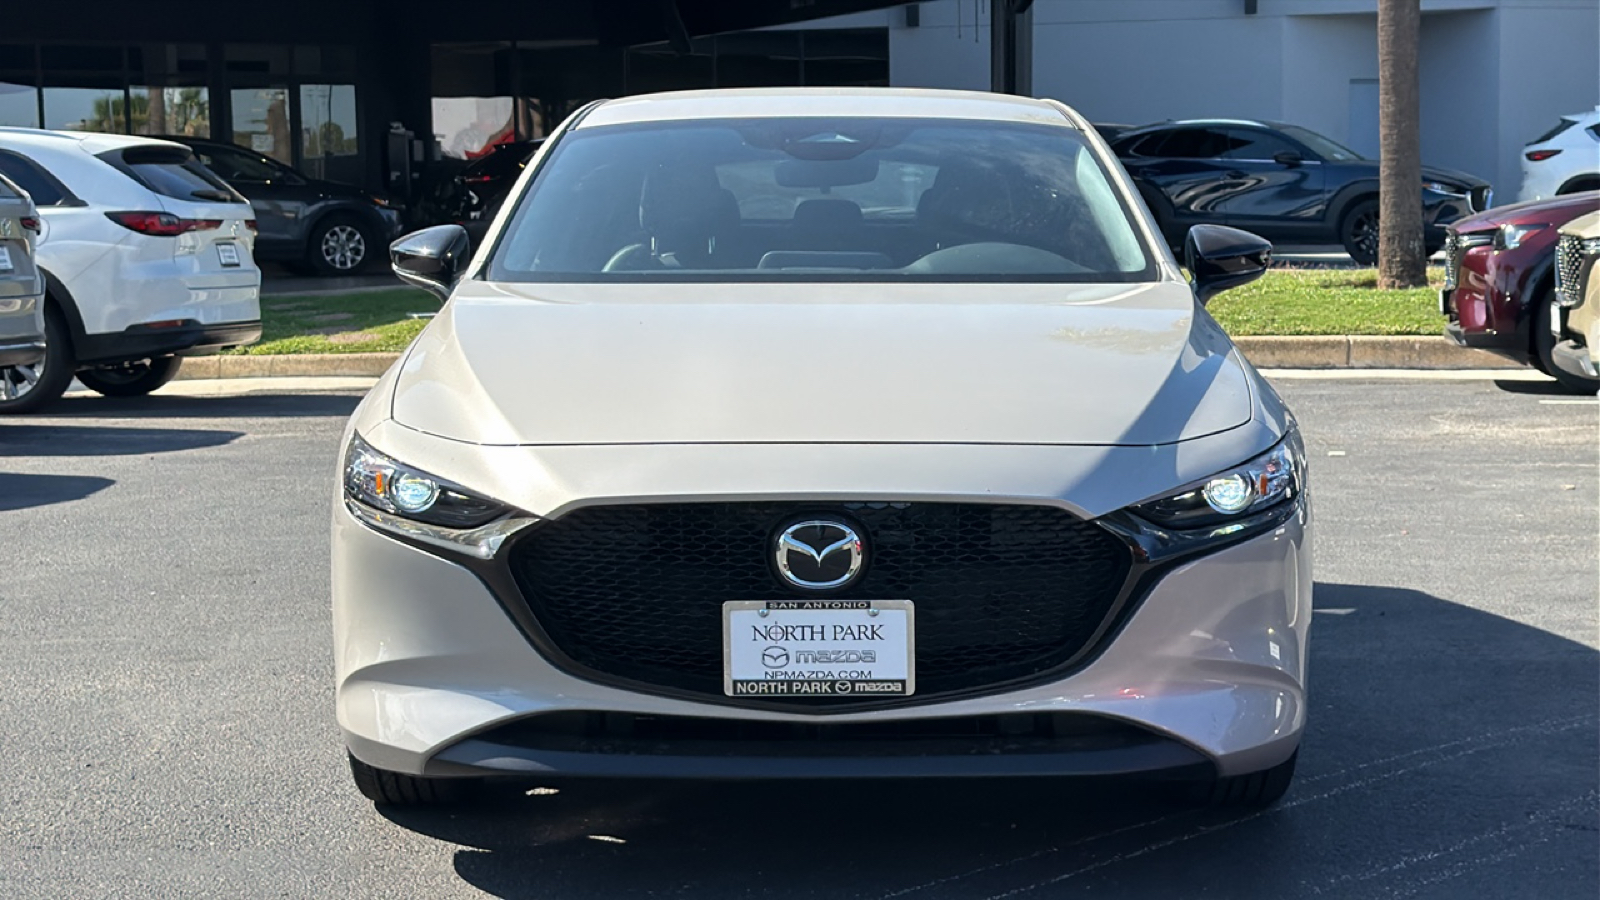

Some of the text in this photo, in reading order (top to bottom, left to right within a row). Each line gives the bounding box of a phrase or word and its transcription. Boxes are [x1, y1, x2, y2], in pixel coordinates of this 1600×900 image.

[769, 601, 868, 609] SAN ANTONIO
[752, 623, 885, 642] NORTH PARK
[795, 649, 876, 664] mazda
[764, 670, 872, 680] NPMAZDA.COM
[736, 681, 903, 694] NORTH PARK mazda
